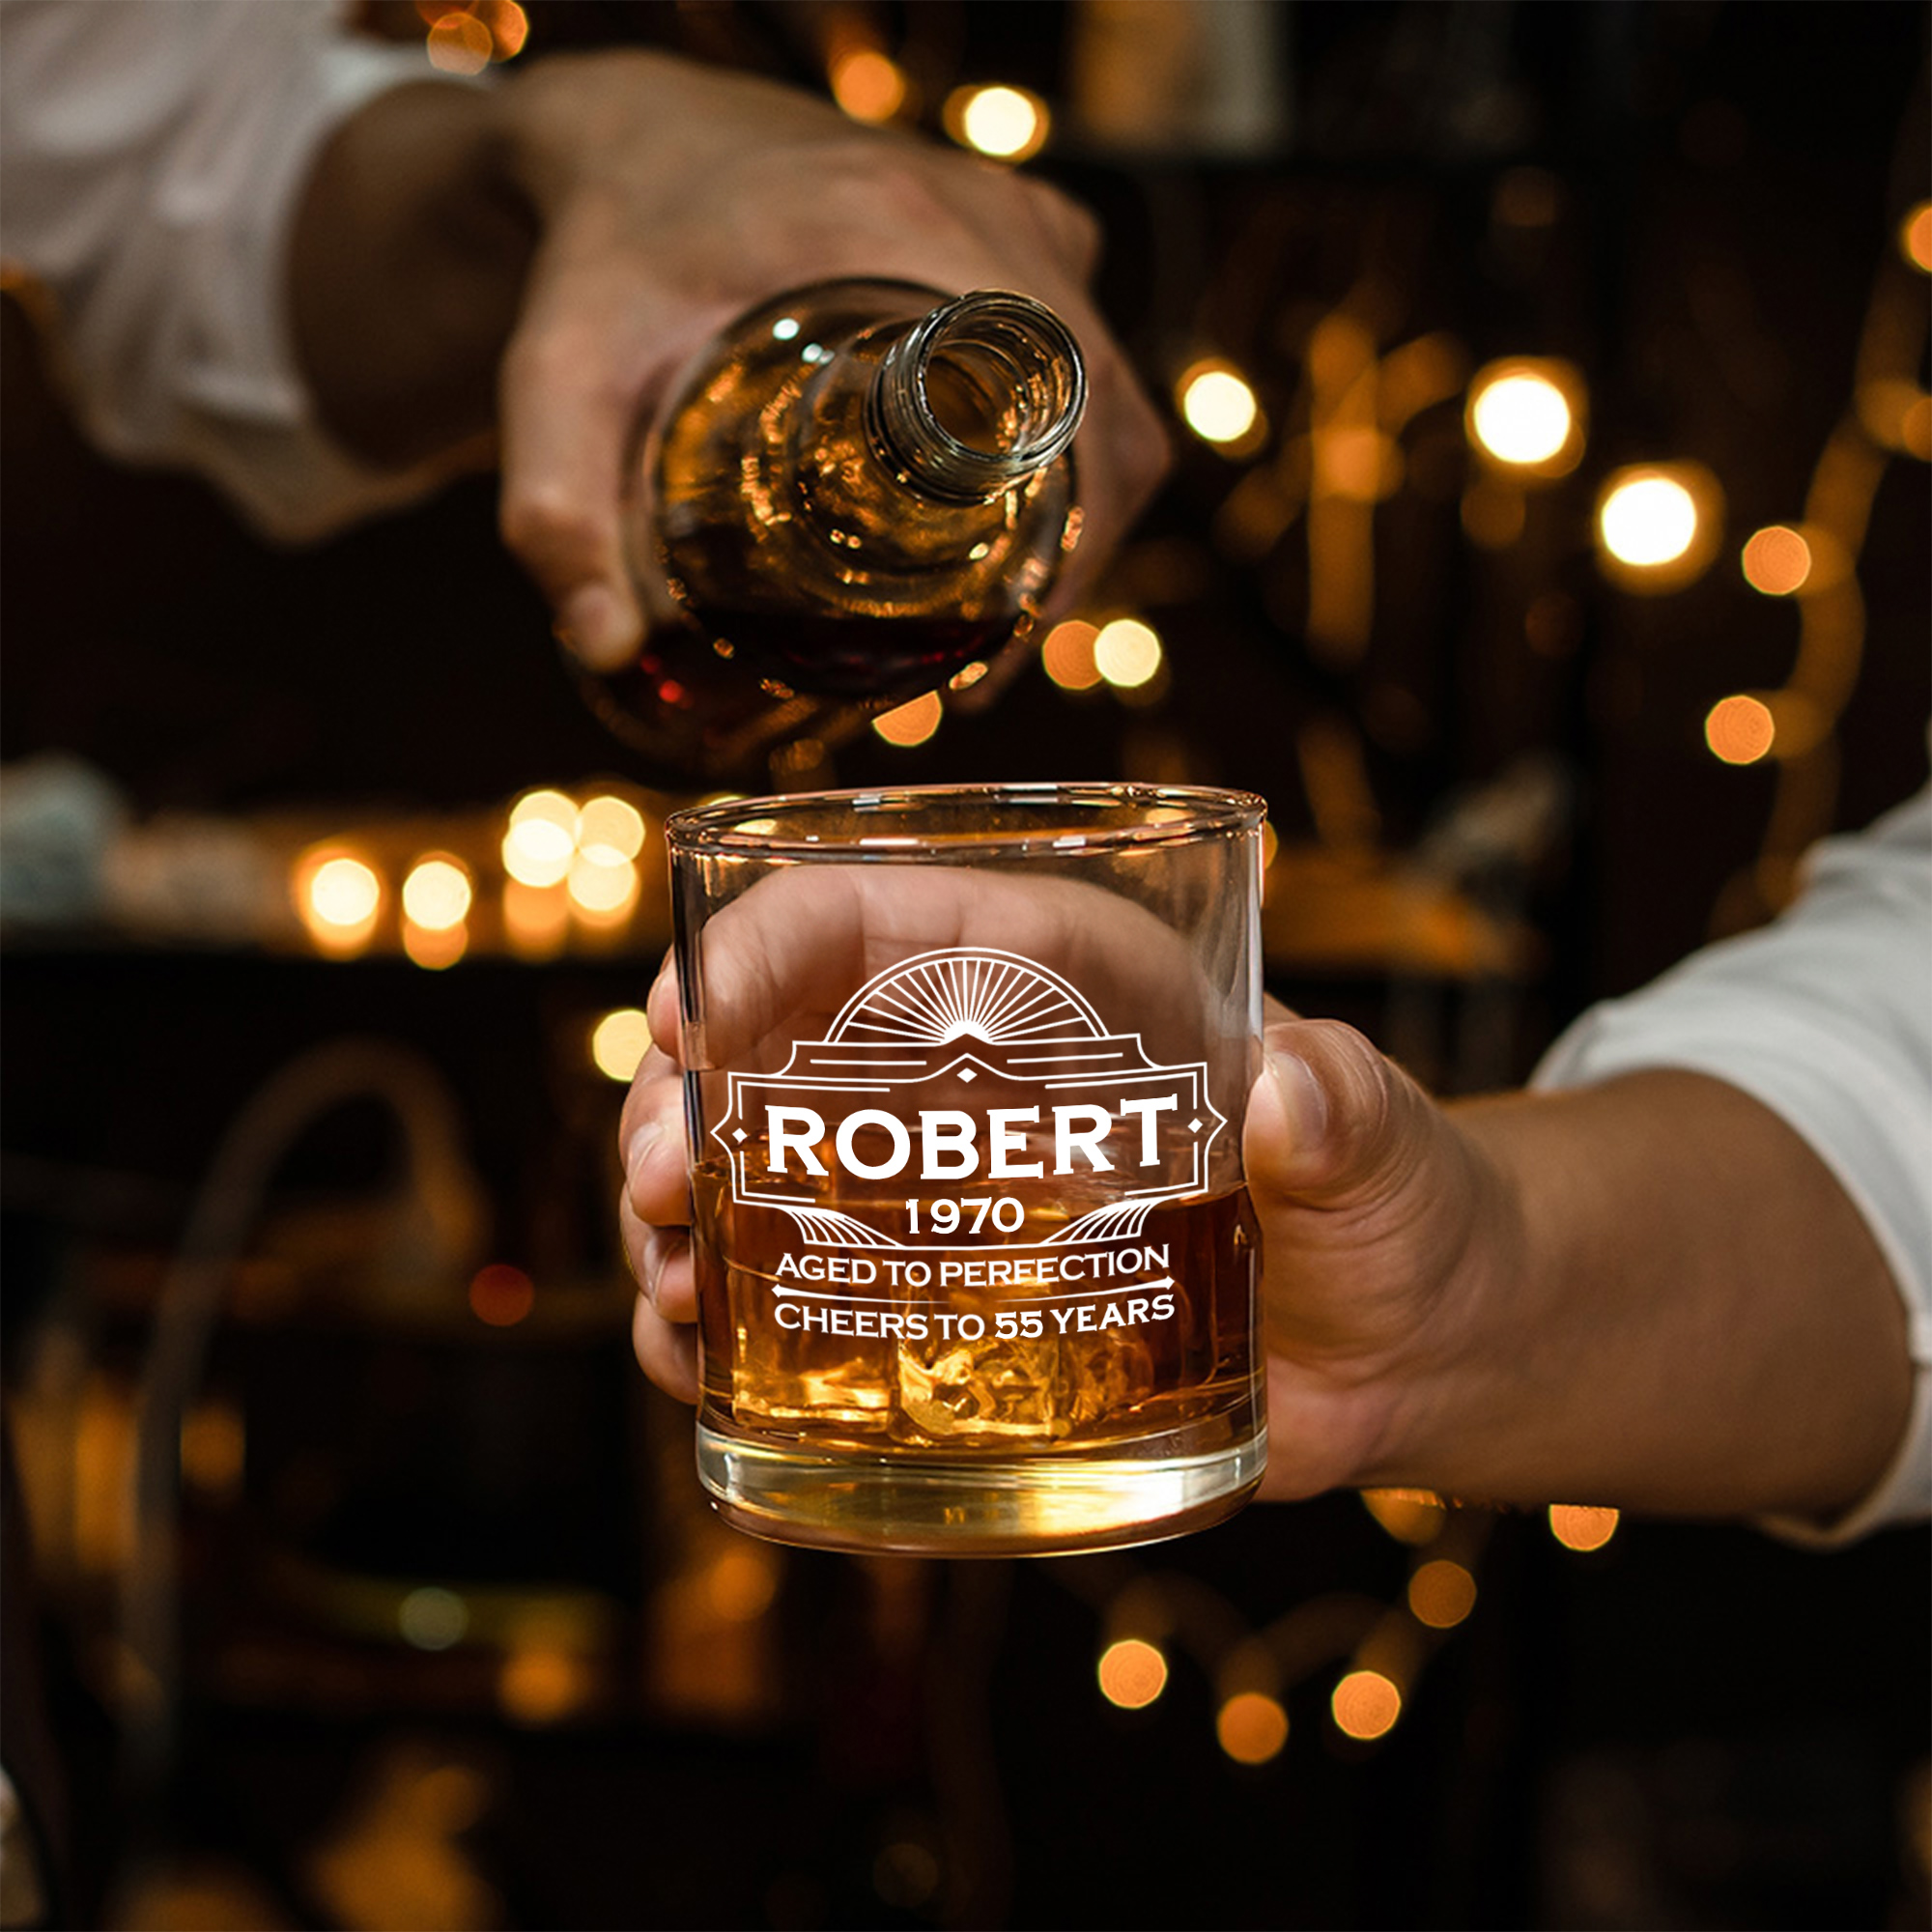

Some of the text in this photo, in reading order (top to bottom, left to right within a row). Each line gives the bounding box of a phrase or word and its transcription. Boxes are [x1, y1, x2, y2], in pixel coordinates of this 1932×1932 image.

[765, 1093, 1179, 1179] ROBERT
[905, 1196, 1025, 1235] 1970
[775, 1243, 1170, 1288] AGED TO PERFECTION
[774, 1293, 1176, 1341] CHEERS TO 55 YEARS
